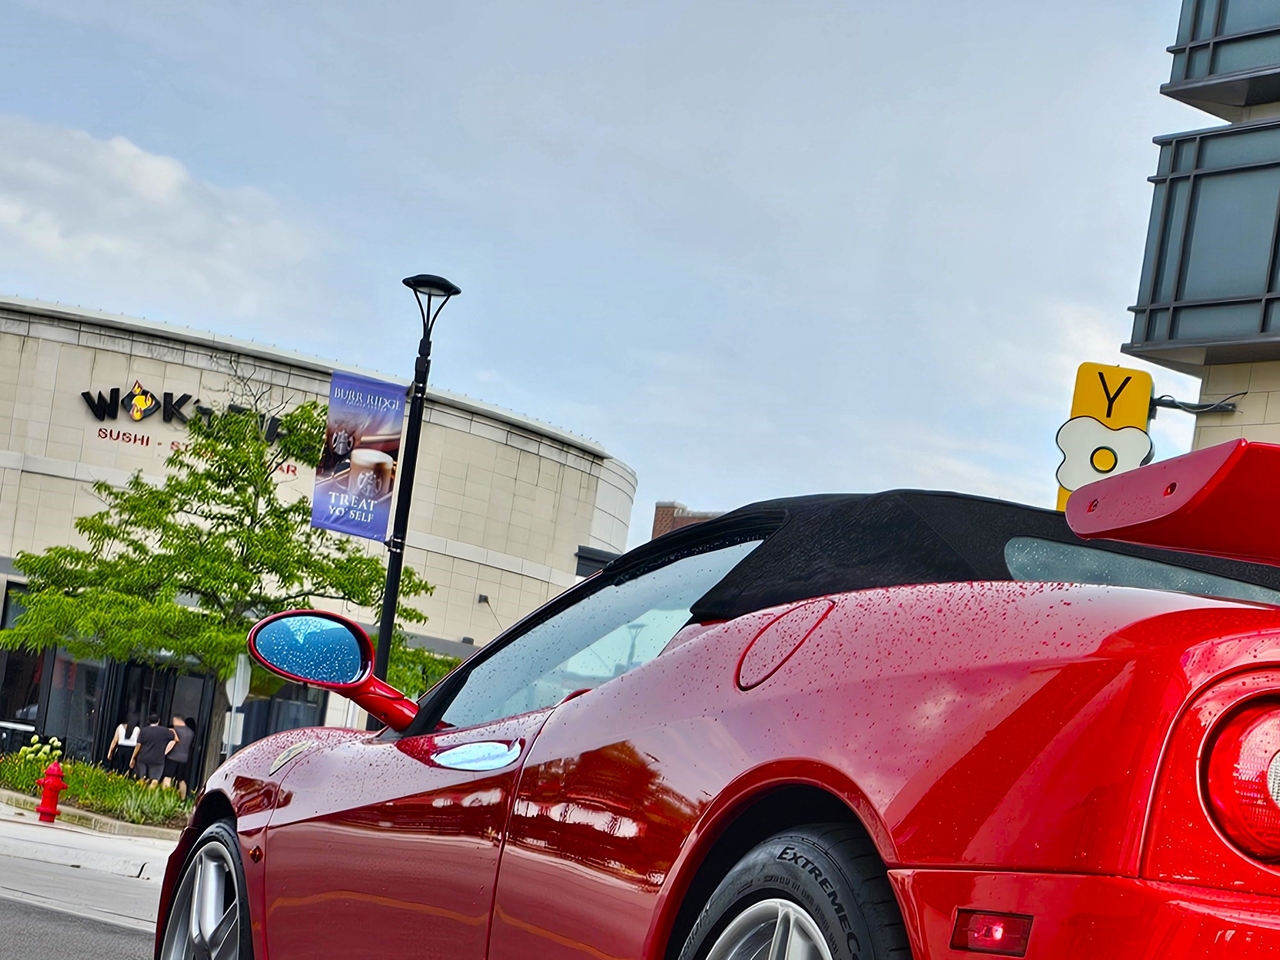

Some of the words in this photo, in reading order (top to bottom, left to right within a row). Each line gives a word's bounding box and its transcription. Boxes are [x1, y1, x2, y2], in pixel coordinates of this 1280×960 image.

[334, 387, 363, 403] BURR
[1098, 371, 1133, 418] Y
[97, 427, 151, 447] SUSHI
[328, 491, 378, 512] TREAT
